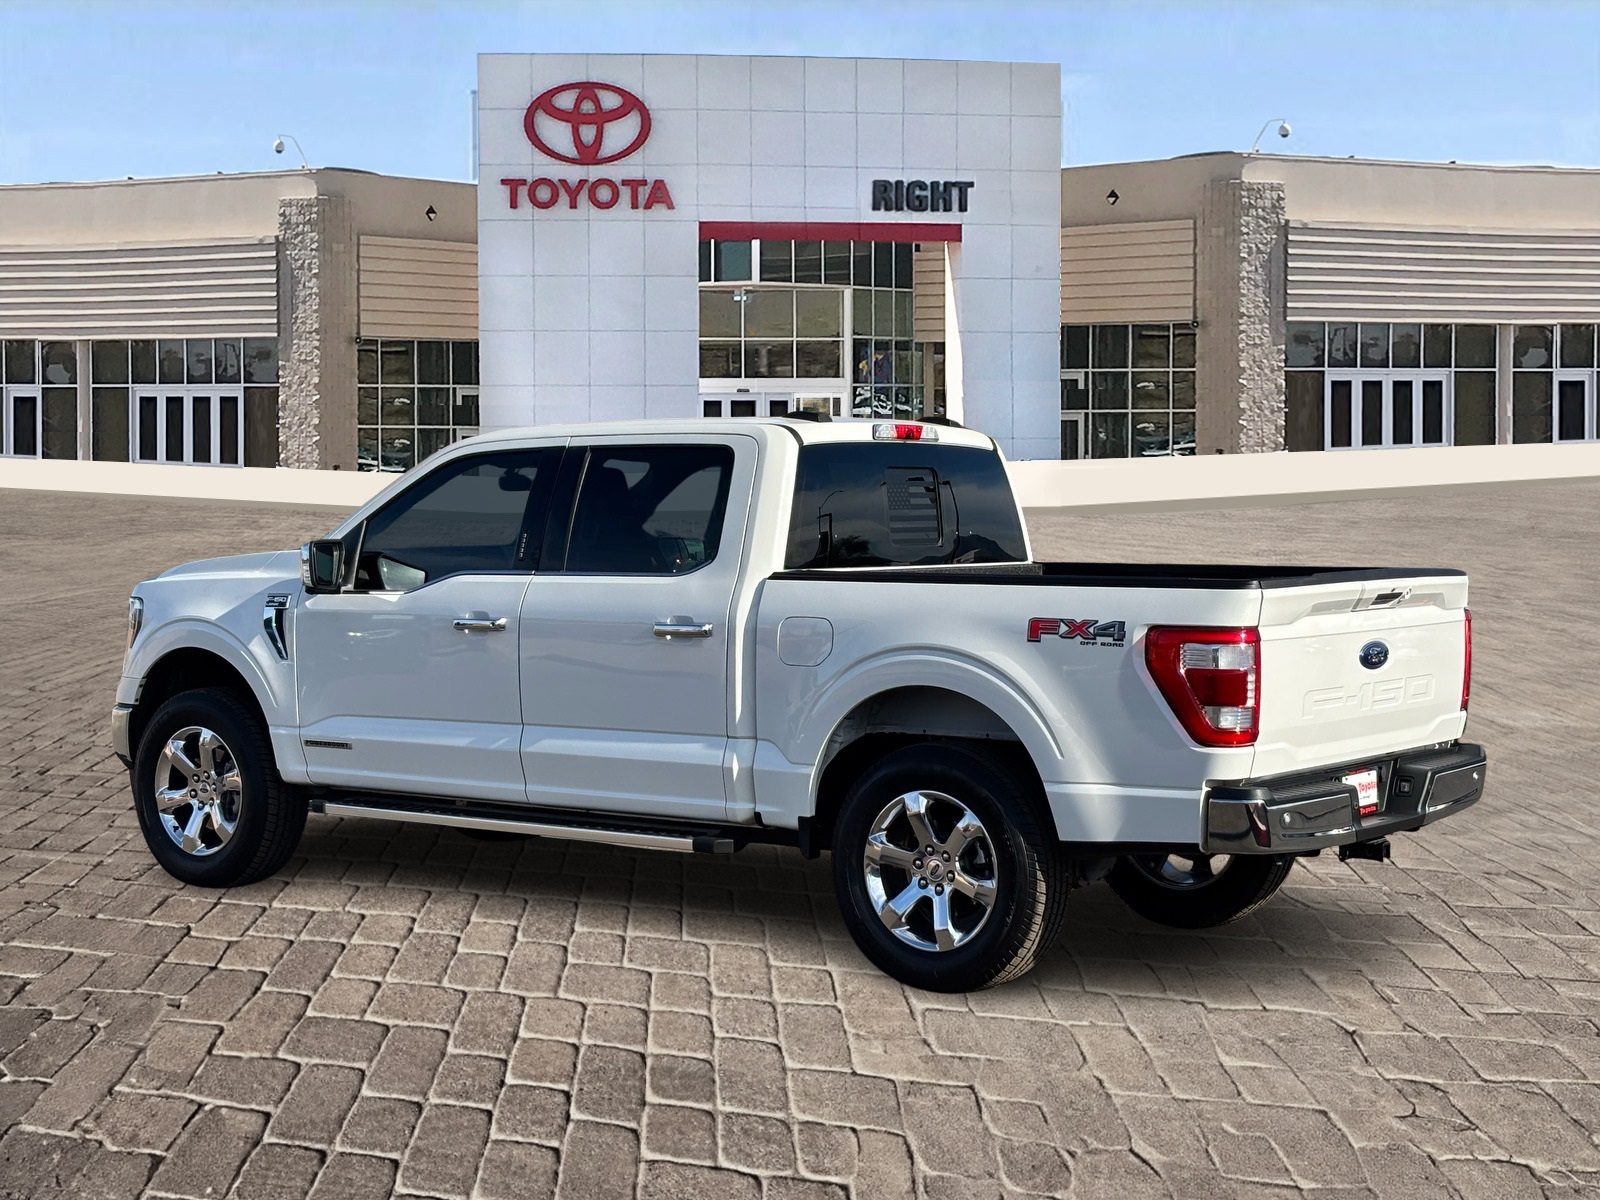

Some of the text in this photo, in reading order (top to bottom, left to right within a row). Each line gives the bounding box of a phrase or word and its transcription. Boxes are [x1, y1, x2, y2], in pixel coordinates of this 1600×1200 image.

[500, 179, 675, 210] TOYOTA
[871, 179, 975, 213] RIGHT
[1027, 617, 1126, 642] FX4
[1302, 673, 1436, 719] F-150
